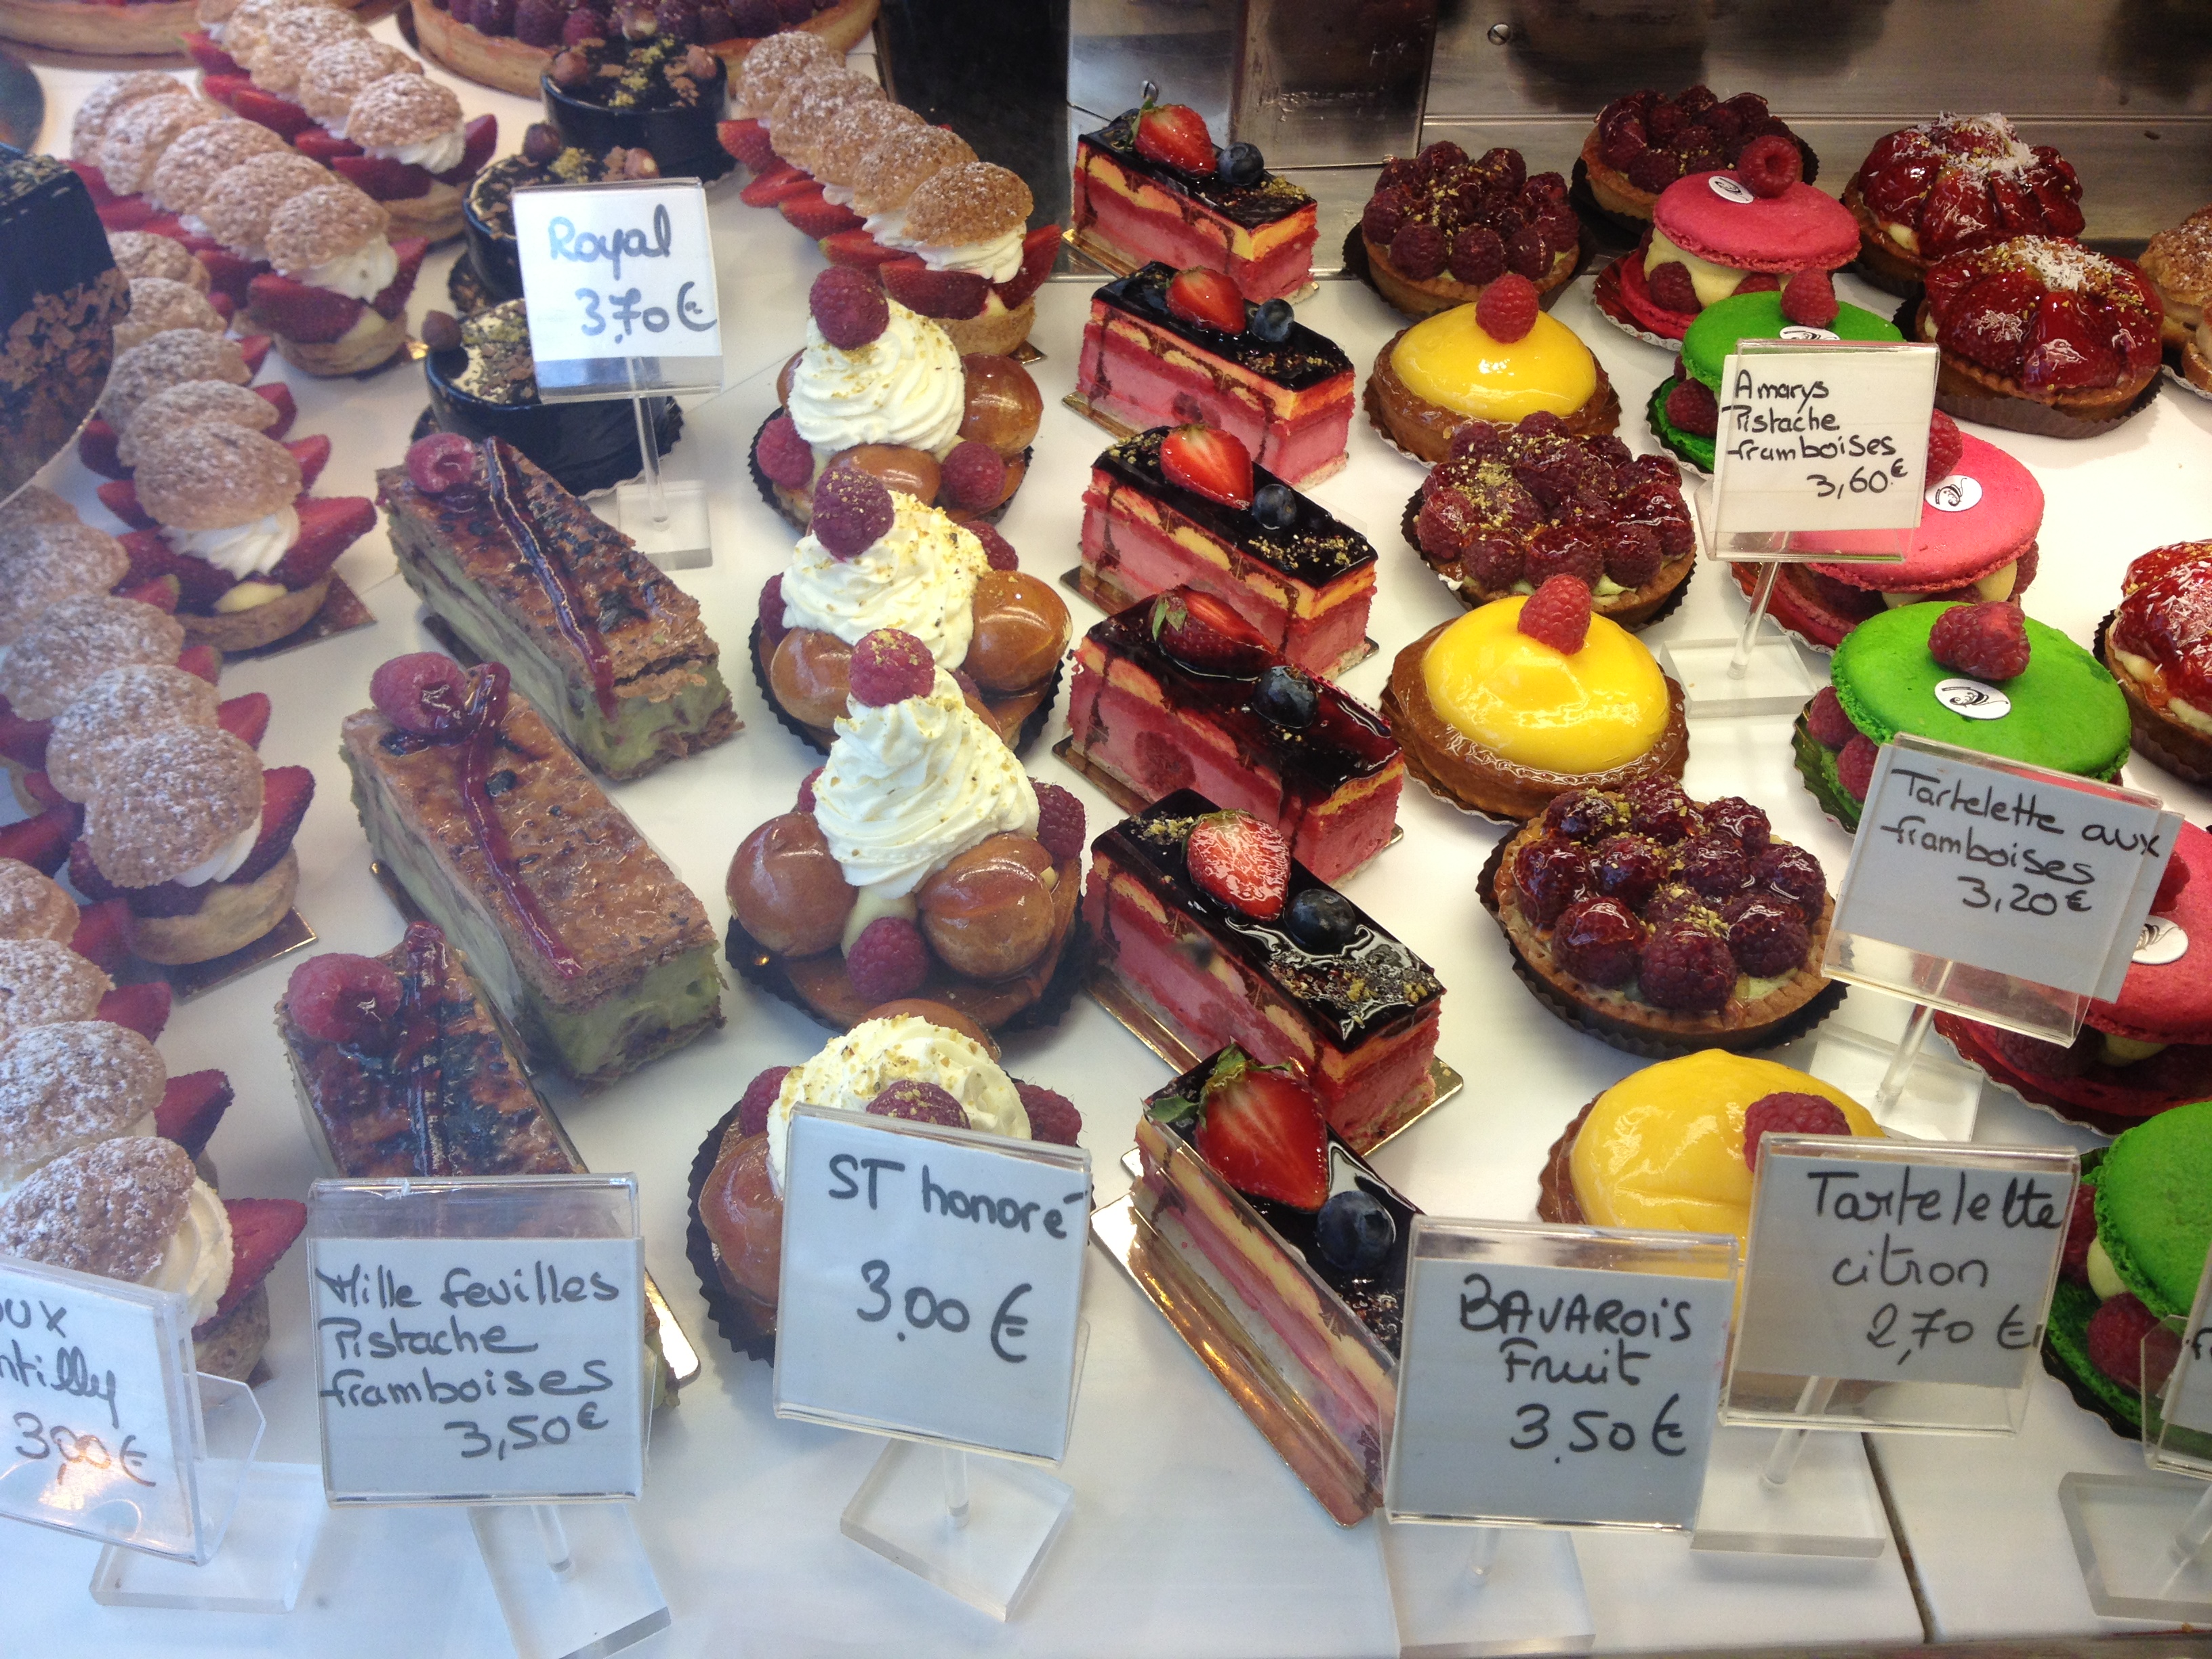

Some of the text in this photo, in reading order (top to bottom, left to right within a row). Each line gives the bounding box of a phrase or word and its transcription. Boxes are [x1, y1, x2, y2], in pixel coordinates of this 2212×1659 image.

[548, 203, 671, 281] Royal
[1735, 369, 1829, 413] Amarys
[1721, 405, 1840, 433] Pistache
[1726, 434, 1896, 460] framboises
[1891, 769, 2160, 857] Tartelette aux
[1880, 815, 2095, 884] framboises
[829, 1153, 1088, 1239] ST honoré
[1807, 1166, 2062, 1229] Tartelette
[315, 1261, 619, 1309] Mille feuilles
[1832, 1233, 1988, 1288] citron
[317, 1315, 539, 1359] Pistache
[1499, 1337, 1651, 1386] Fruit
[320, 1360, 613, 1408] framboises
